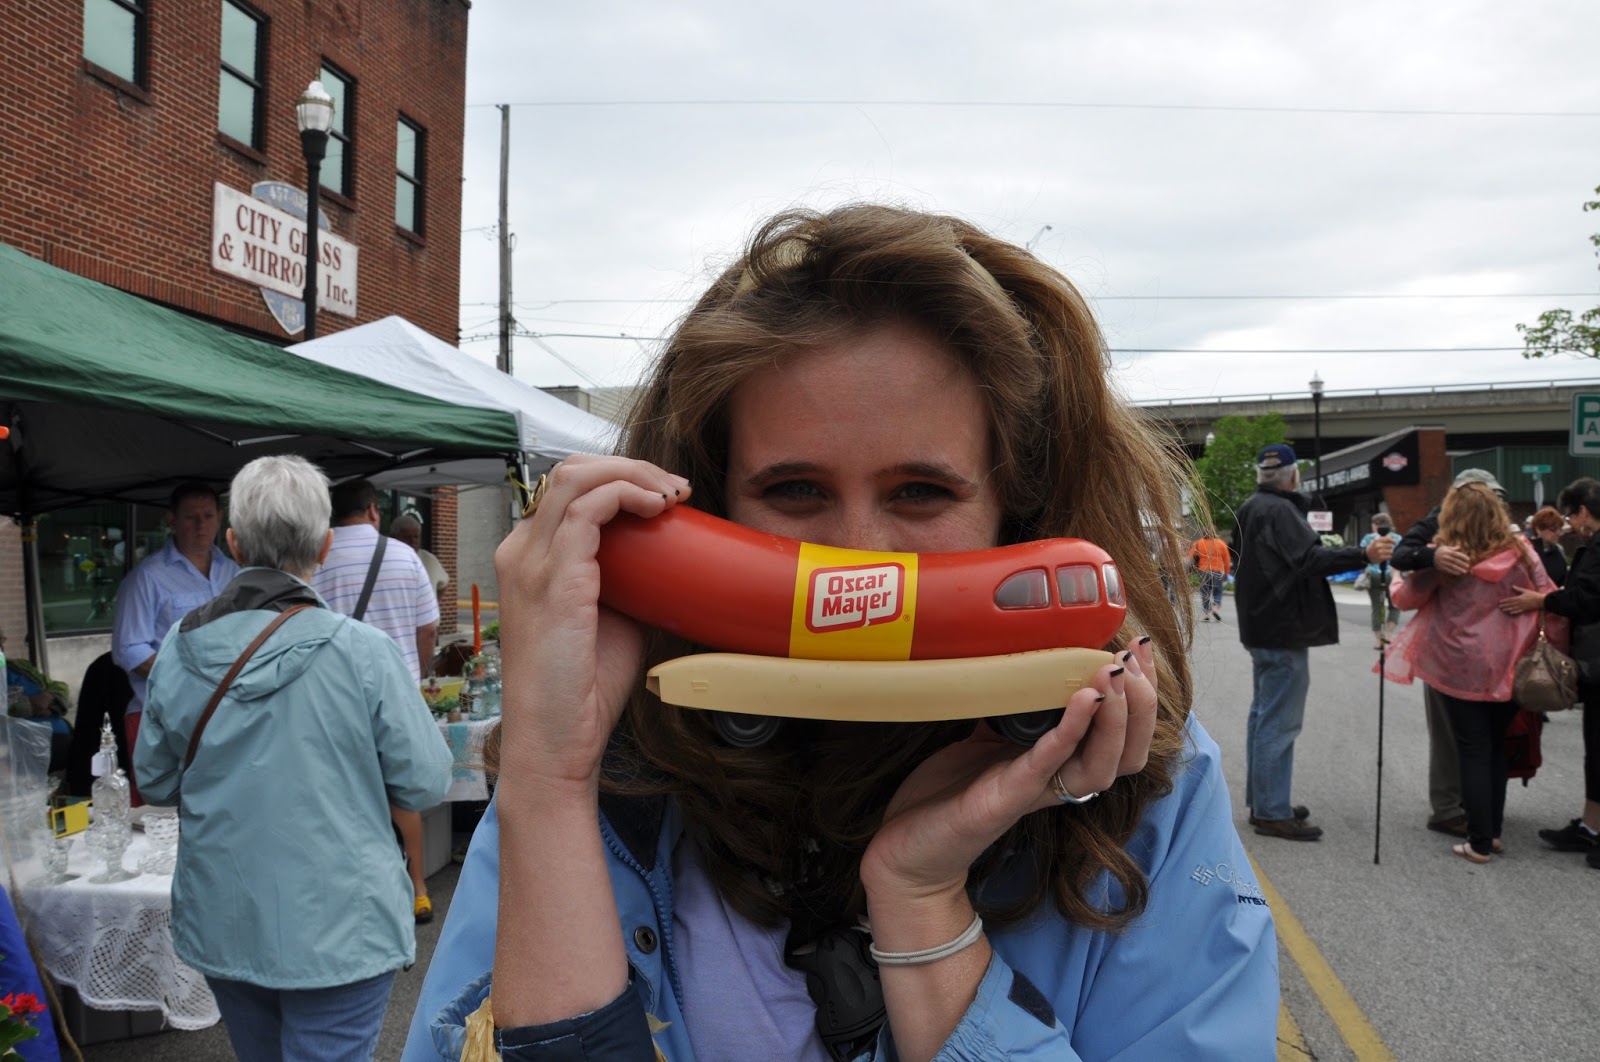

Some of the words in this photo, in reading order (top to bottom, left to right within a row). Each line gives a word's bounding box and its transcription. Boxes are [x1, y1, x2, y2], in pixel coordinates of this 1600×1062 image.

[236, 204, 282, 245] CITY
[289, 228, 341, 271] GLSS
[218, 233, 234, 261] &
[243, 241, 311, 288] MIRRO
[325, 274, 353, 305] Inc.
[821, 590, 891, 626] Mayer
[827, 573, 887, 595] Oscar
